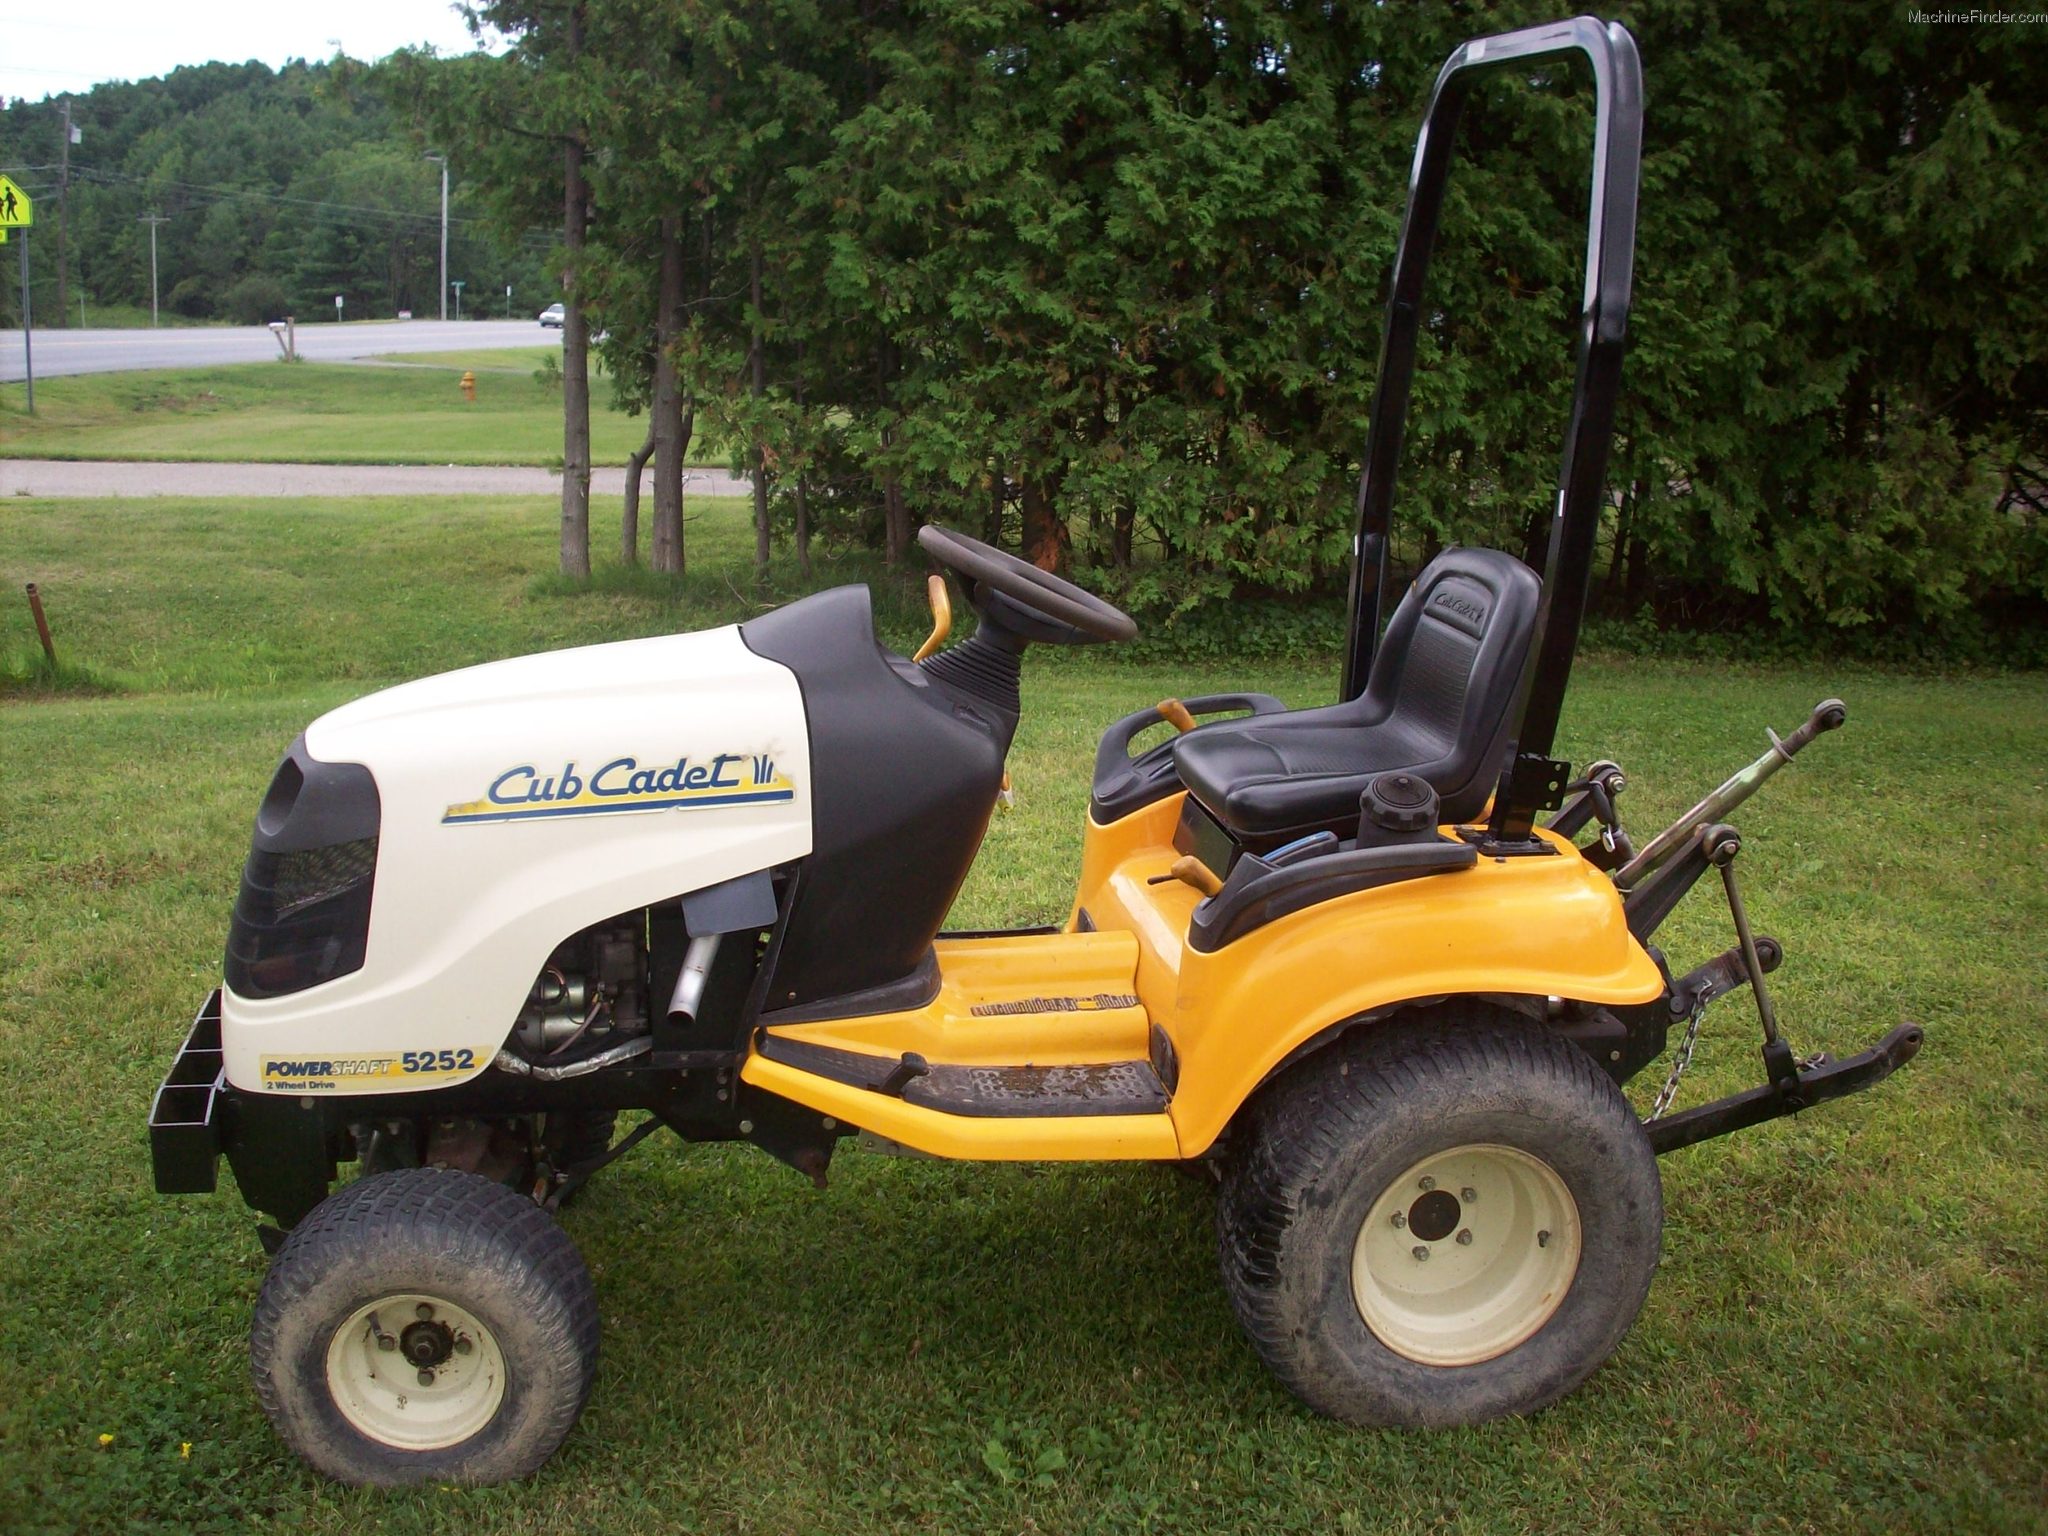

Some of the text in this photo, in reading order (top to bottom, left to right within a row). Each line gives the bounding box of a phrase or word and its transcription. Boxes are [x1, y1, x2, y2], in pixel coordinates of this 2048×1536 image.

[488, 753, 746, 804] Cub Cadet
[265, 1048, 475, 1077] POWERSHAFT 5252
[266, 1080, 336, 1090] 2 Wheel Drive
